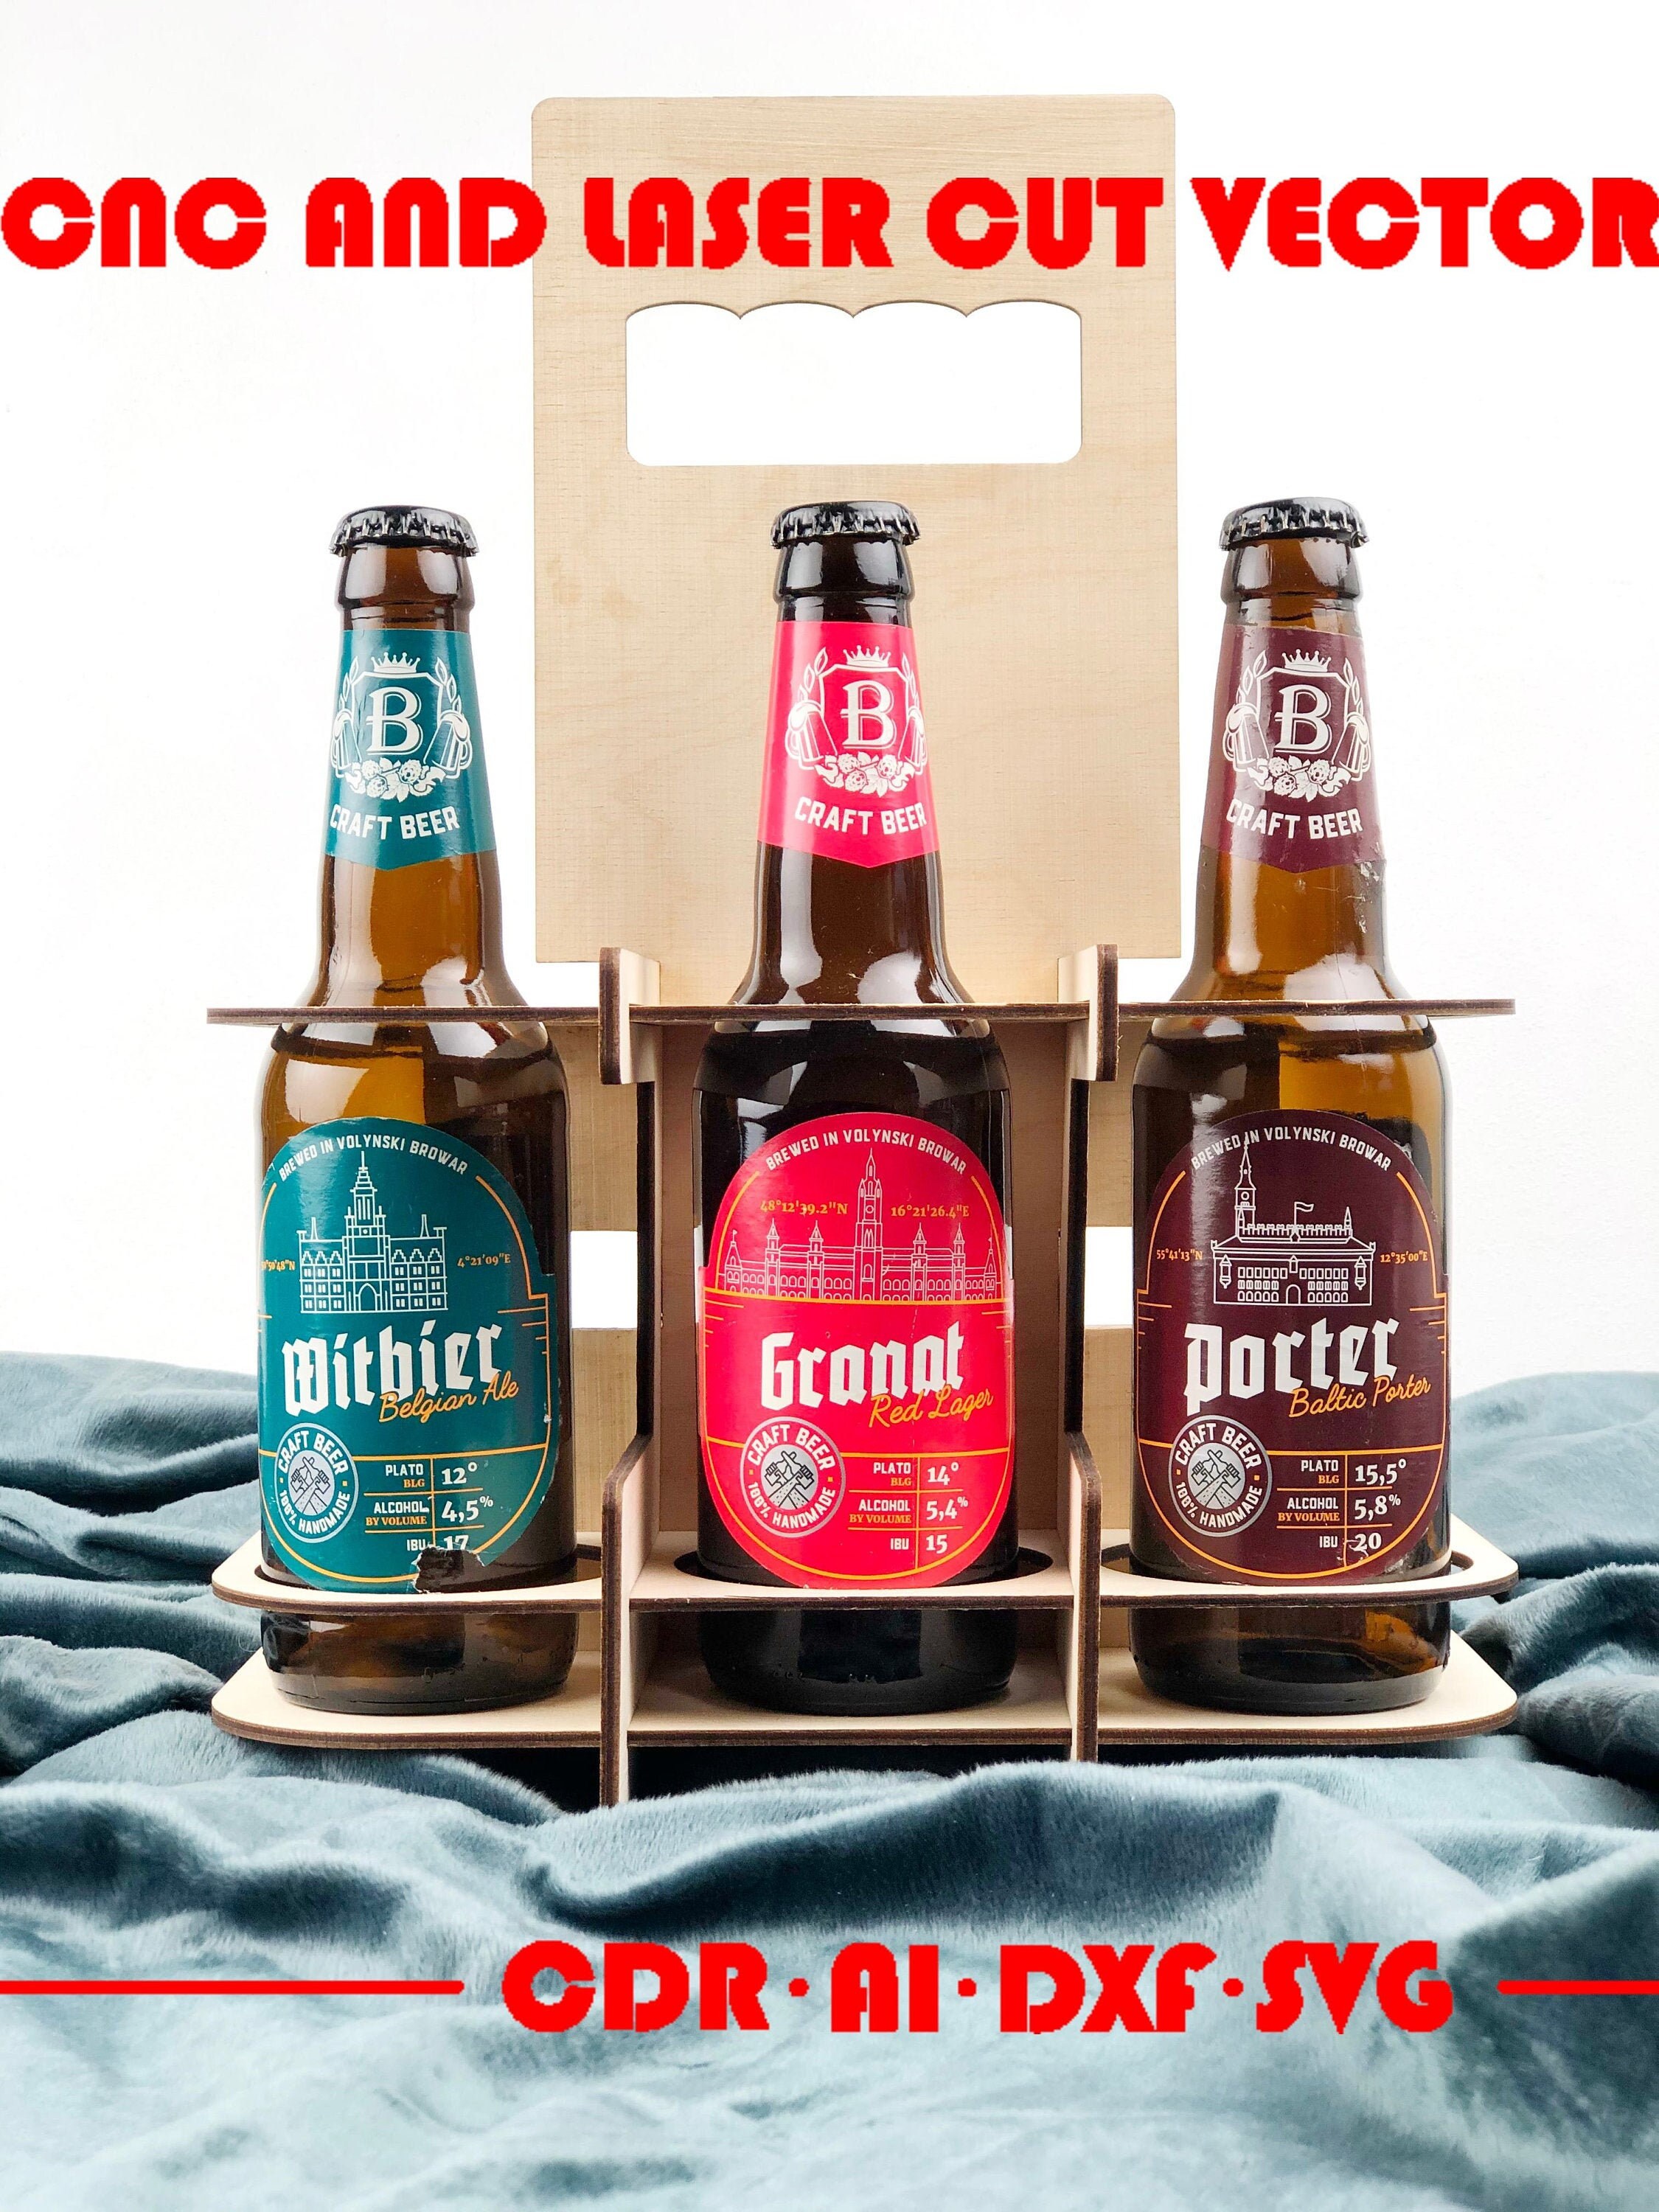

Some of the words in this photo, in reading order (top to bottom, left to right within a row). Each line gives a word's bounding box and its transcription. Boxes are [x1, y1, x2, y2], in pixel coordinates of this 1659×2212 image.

[366, 686, 424, 756] B
[840, 680, 897, 750] B
[1274, 684, 1332, 755] B
[330, 803, 392, 841] CRAFT
[400, 805, 460, 841] BEER
[795, 796, 873, 835] CRAFT
[880, 801, 928, 835] BEER
[1225, 799, 1300, 839] CRAFT
[1307, 808, 1363, 840] BEER
[279, 1146, 317, 1181] BREWED
[320, 1138, 333, 1154] IN
[337, 1135, 405, 1151] VOLYNSKI
[410, 1140, 468, 1175] BROWAR
[765, 1135, 819, 1171] BREWED
[824, 1132, 839, 1146] IN
[843, 1129, 914, 1147] VOLYNSKI
[918, 1138, 967, 1175] BROWAR
[1191, 1138, 1239, 1171] BREWED
[1244, 1130, 1259, 1144] IN
[1264, 1126, 1336, 1145] VOLYNSKI
[1340, 1134, 1392, 1172] BROWAR
[282, 1320, 502, 1416] Witbier
[762, 1321, 964, 1411] Granat
[378, 1388, 477, 1423] Belgian
[482, 1369, 518, 1405] Ale
[869, 1388, 924, 1428] Red
[928, 1383, 994, 1423] Lager
[1289, 1382, 1368, 1417] Baltic
[1372, 1374, 1431, 1408] Porter
[279, 1430, 308, 1472] CRAFT
[313, 1433, 349, 1475] BEER
[748, 1425, 790, 1466] CRAFT
[795, 1427, 836, 1471] BEER
[1175, 1422, 1217, 1466] CRAFT
[1221, 1426, 1262, 1470] BEER
[1301, 1460, 1338, 1472] PLATO
[385, 1464, 423, 1476] PLATO
[403, 1478, 425, 1488] BLG
[874, 1462, 911, 1475] PLATO
[891, 1477, 911, 1486] BLG
[1318, 1475, 1339, 1485] BLG
[279, 1491, 296, 1525] 100%
[299, 1492, 350, 1535] HANDMADE
[366, 1517, 379, 1526] BY
[381, 1515, 427, 1526] VOLUME
[374, 1501, 428, 1514] ALCOHOL
[748, 1482, 770, 1520] 100%
[771, 1486, 836, 1529] HANDMADE
[849, 1514, 863, 1523] BY
[866, 1514, 911, 1523] VOLUME
[858, 1499, 911, 1512] ALCOHOL
[1175, 1481, 1196, 1518] 100%
[1200, 1485, 1263, 1528] HANDMADE
[1278, 1512, 1292, 1522] BY
[1294, 1512, 1340, 1522] VOLUME
[1287, 1498, 1338, 1510] ALCOHOL
[407, 1539, 426, 1551] IBU
[442, 1534, 469, 1551] 17
[891, 1538, 909, 1550] IBU
[926, 1534, 947, 1554] 15
[1319, 1536, 1338, 1548] IBU
[1354, 1532, 1381, 1550] 20
